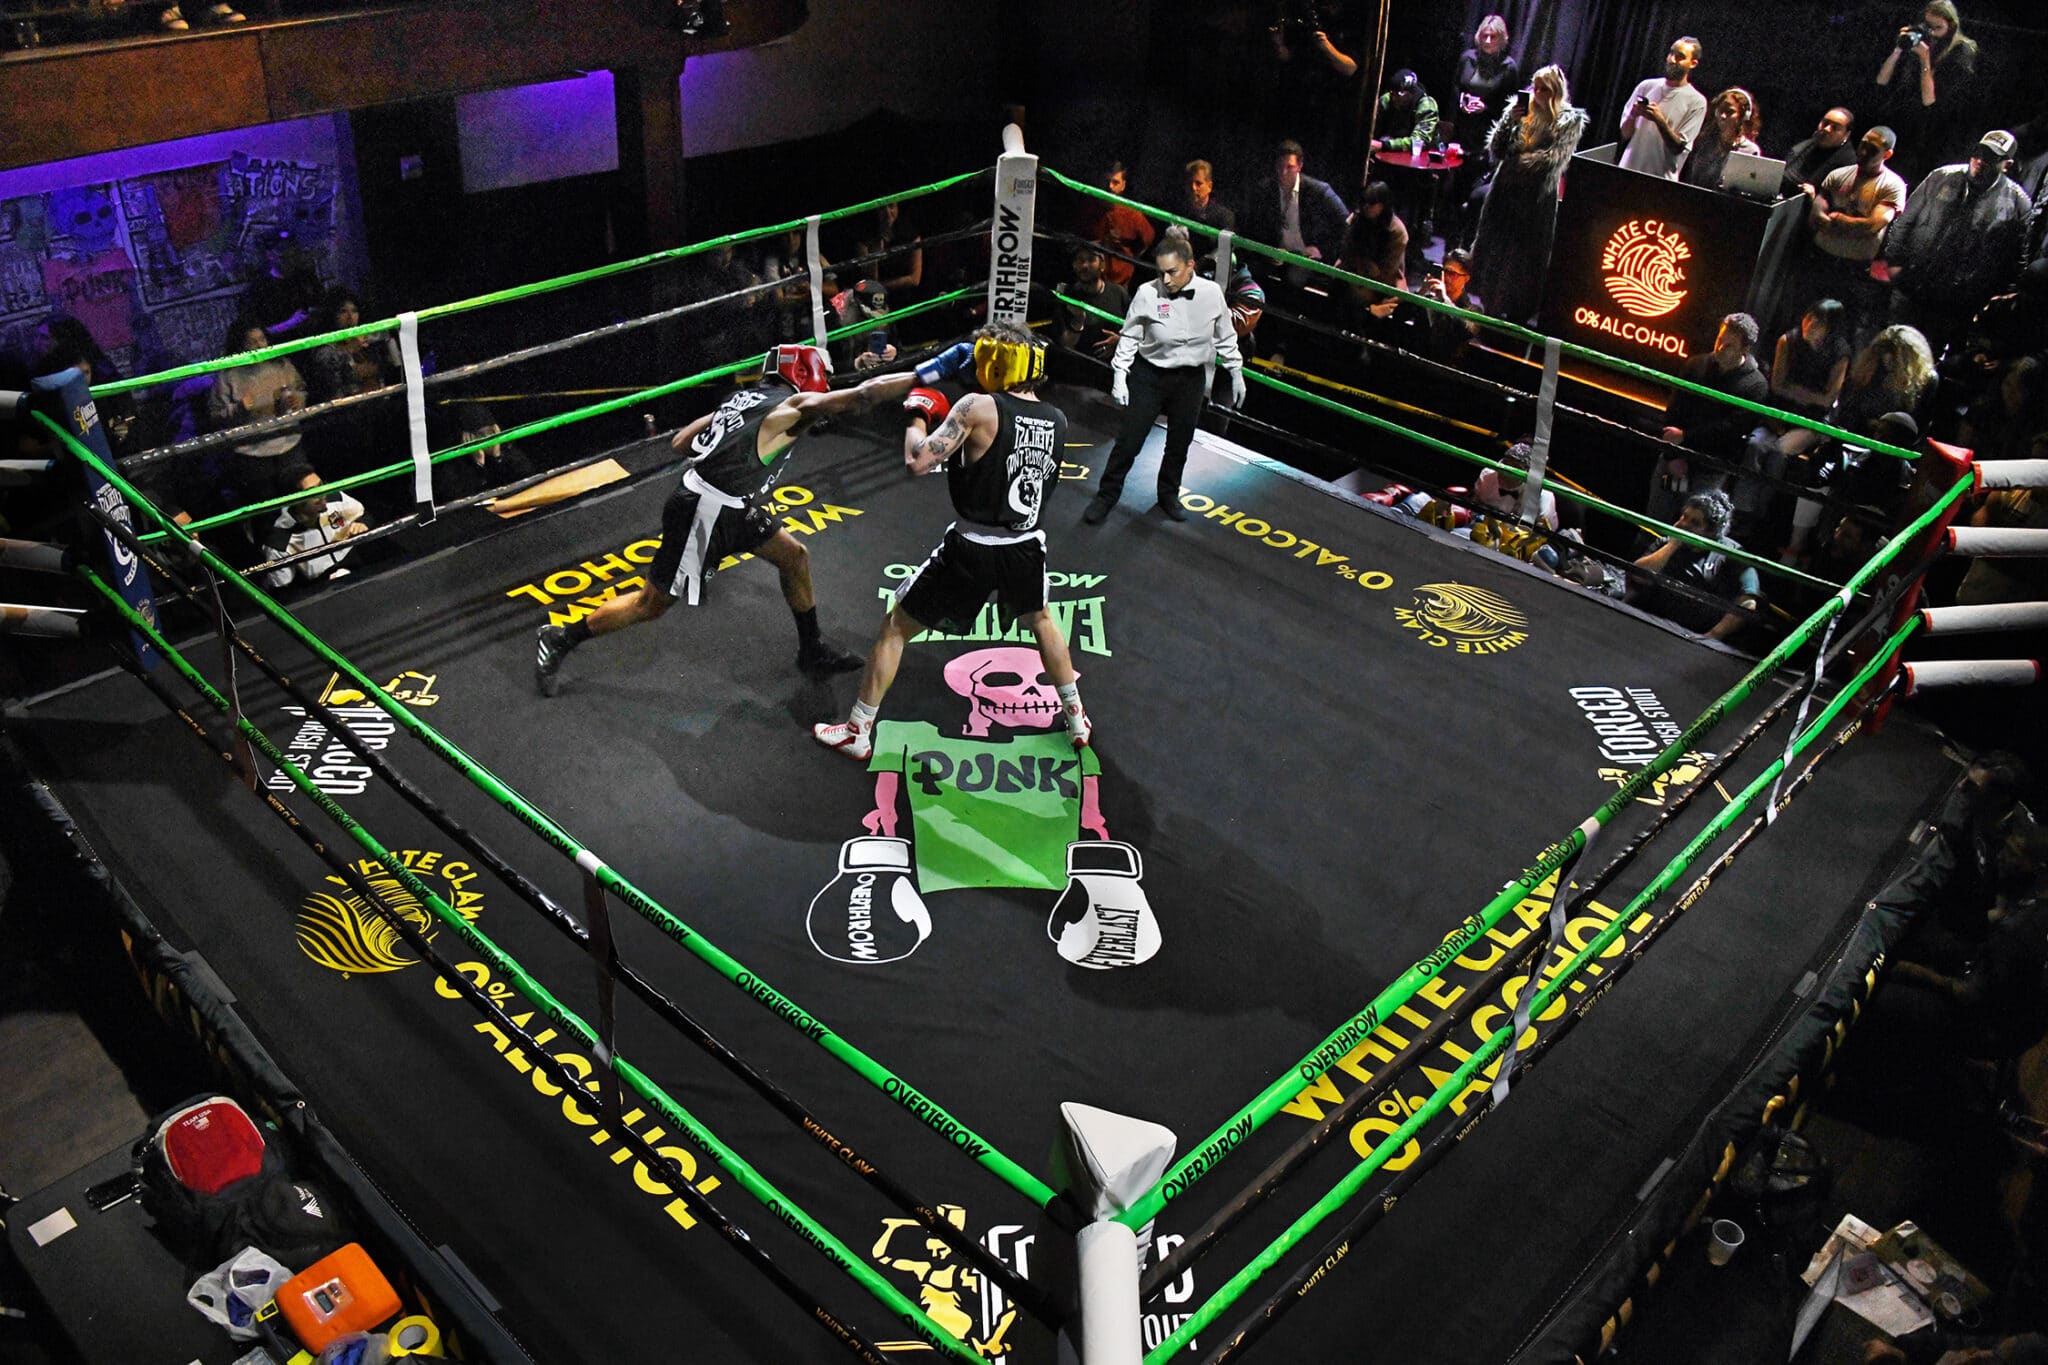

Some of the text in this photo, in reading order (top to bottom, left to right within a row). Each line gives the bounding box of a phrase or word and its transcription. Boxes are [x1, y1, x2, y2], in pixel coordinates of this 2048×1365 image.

[1601, 219, 1692, 270] WHITE CLAW
[1014, 257, 1030, 314] NEW YORK
[1179, 486, 1394, 590] 0% ALCOHO
[505, 533, 664, 605] OHOL
[1393, 607, 1529, 654] WHITE CLAW
[1625, 686, 1683, 746] RISH STOUT
[912, 750, 1079, 798] PUNK
[611, 881, 691, 943] OVERTHROW
[847, 873, 879, 960] OVERTHROW
[1076, 904, 1139, 967] EVERLAST
[1415, 912, 1487, 977] OVERTHROW
[549, 1007, 594, 1051] OVERTHR
[735, 972, 832, 1041] OVERTHROW
[1300, 1004, 1379, 1082] OVERTHROW
[182, 1108, 212, 1127] TEAM USA
[803, 1116, 877, 1176] WHITE CLAW
[883, 1077, 991, 1160] OVERTHROW
[1161, 1113, 1253, 1203] OVERTHROW
[1297, 1241, 1350, 1297] WHITE CLAW
[816, 1305, 851, 1342] WHITE
